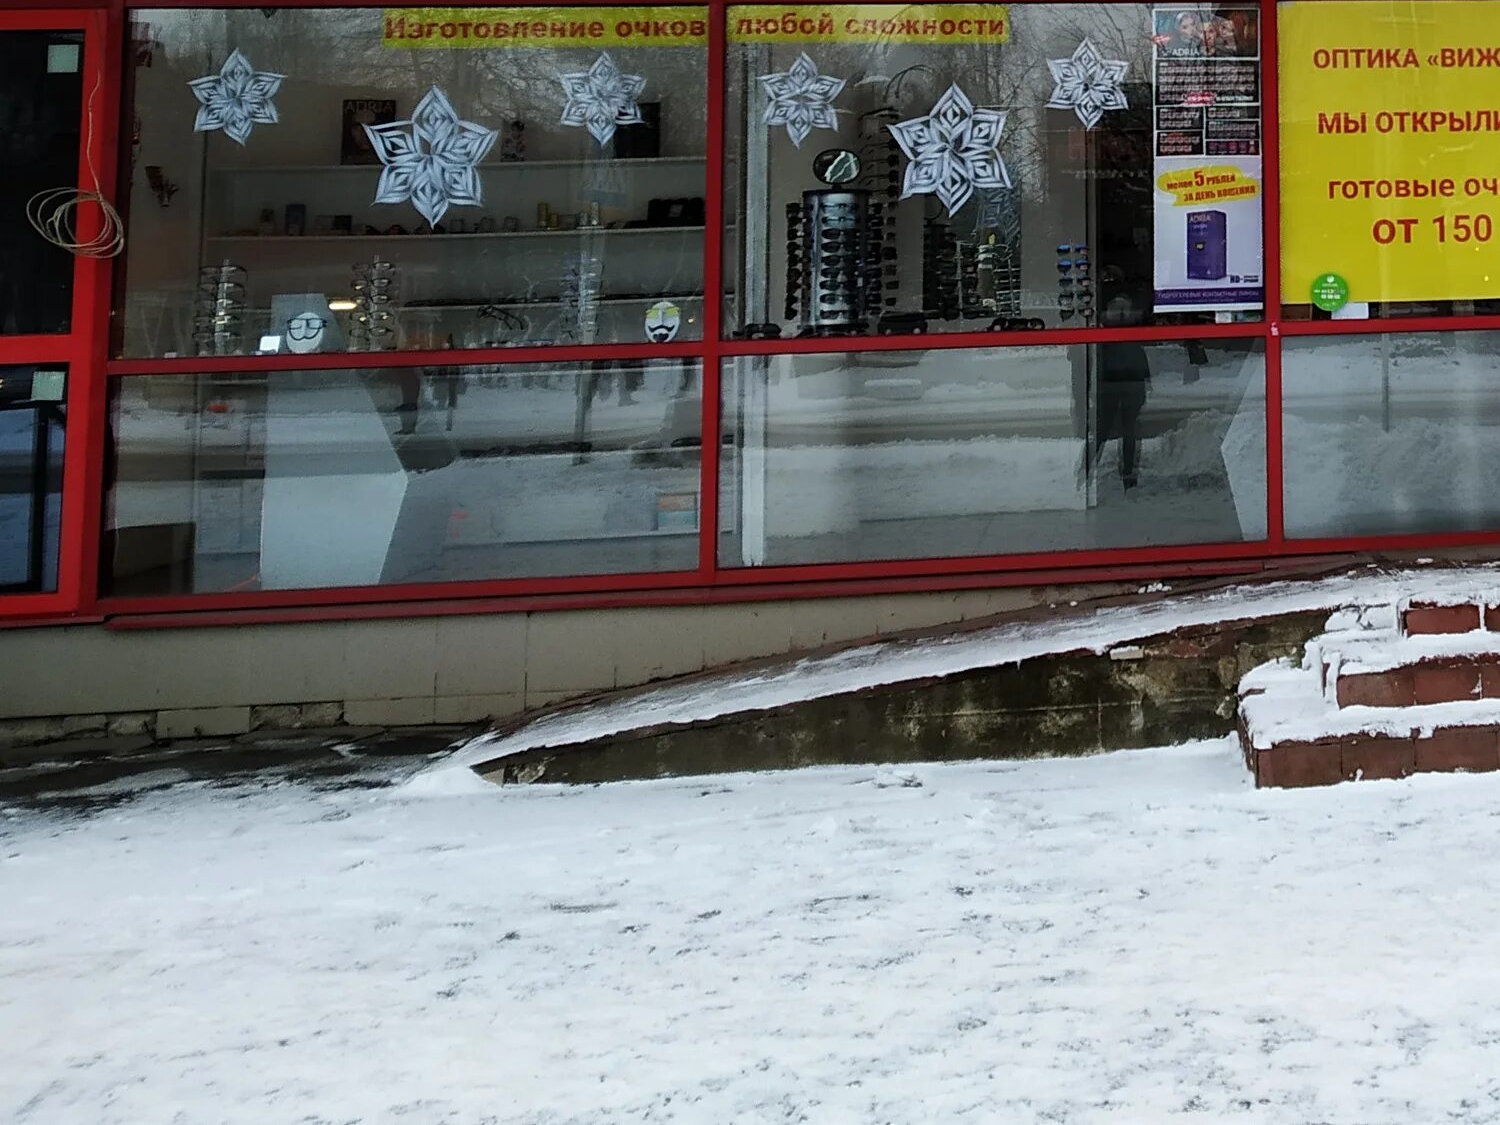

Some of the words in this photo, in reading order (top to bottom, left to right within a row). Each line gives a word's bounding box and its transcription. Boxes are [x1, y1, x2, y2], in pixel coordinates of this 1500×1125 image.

[384, 17, 605, 40] Изготовление
[615, 19, 707, 38] очков
[735, 12, 834, 36] любой
[845, 16, 1005, 36] сложности
[1312, 47, 1420, 69] ОПТИКА
[1317, 112, 1367, 135] МЫ
[1193, 170, 1205, 187] 5
[1328, 179, 1455, 200] готовые
[1194, 191, 1216, 202] ДЕНЬ
[1432, 213, 1493, 244] 150
